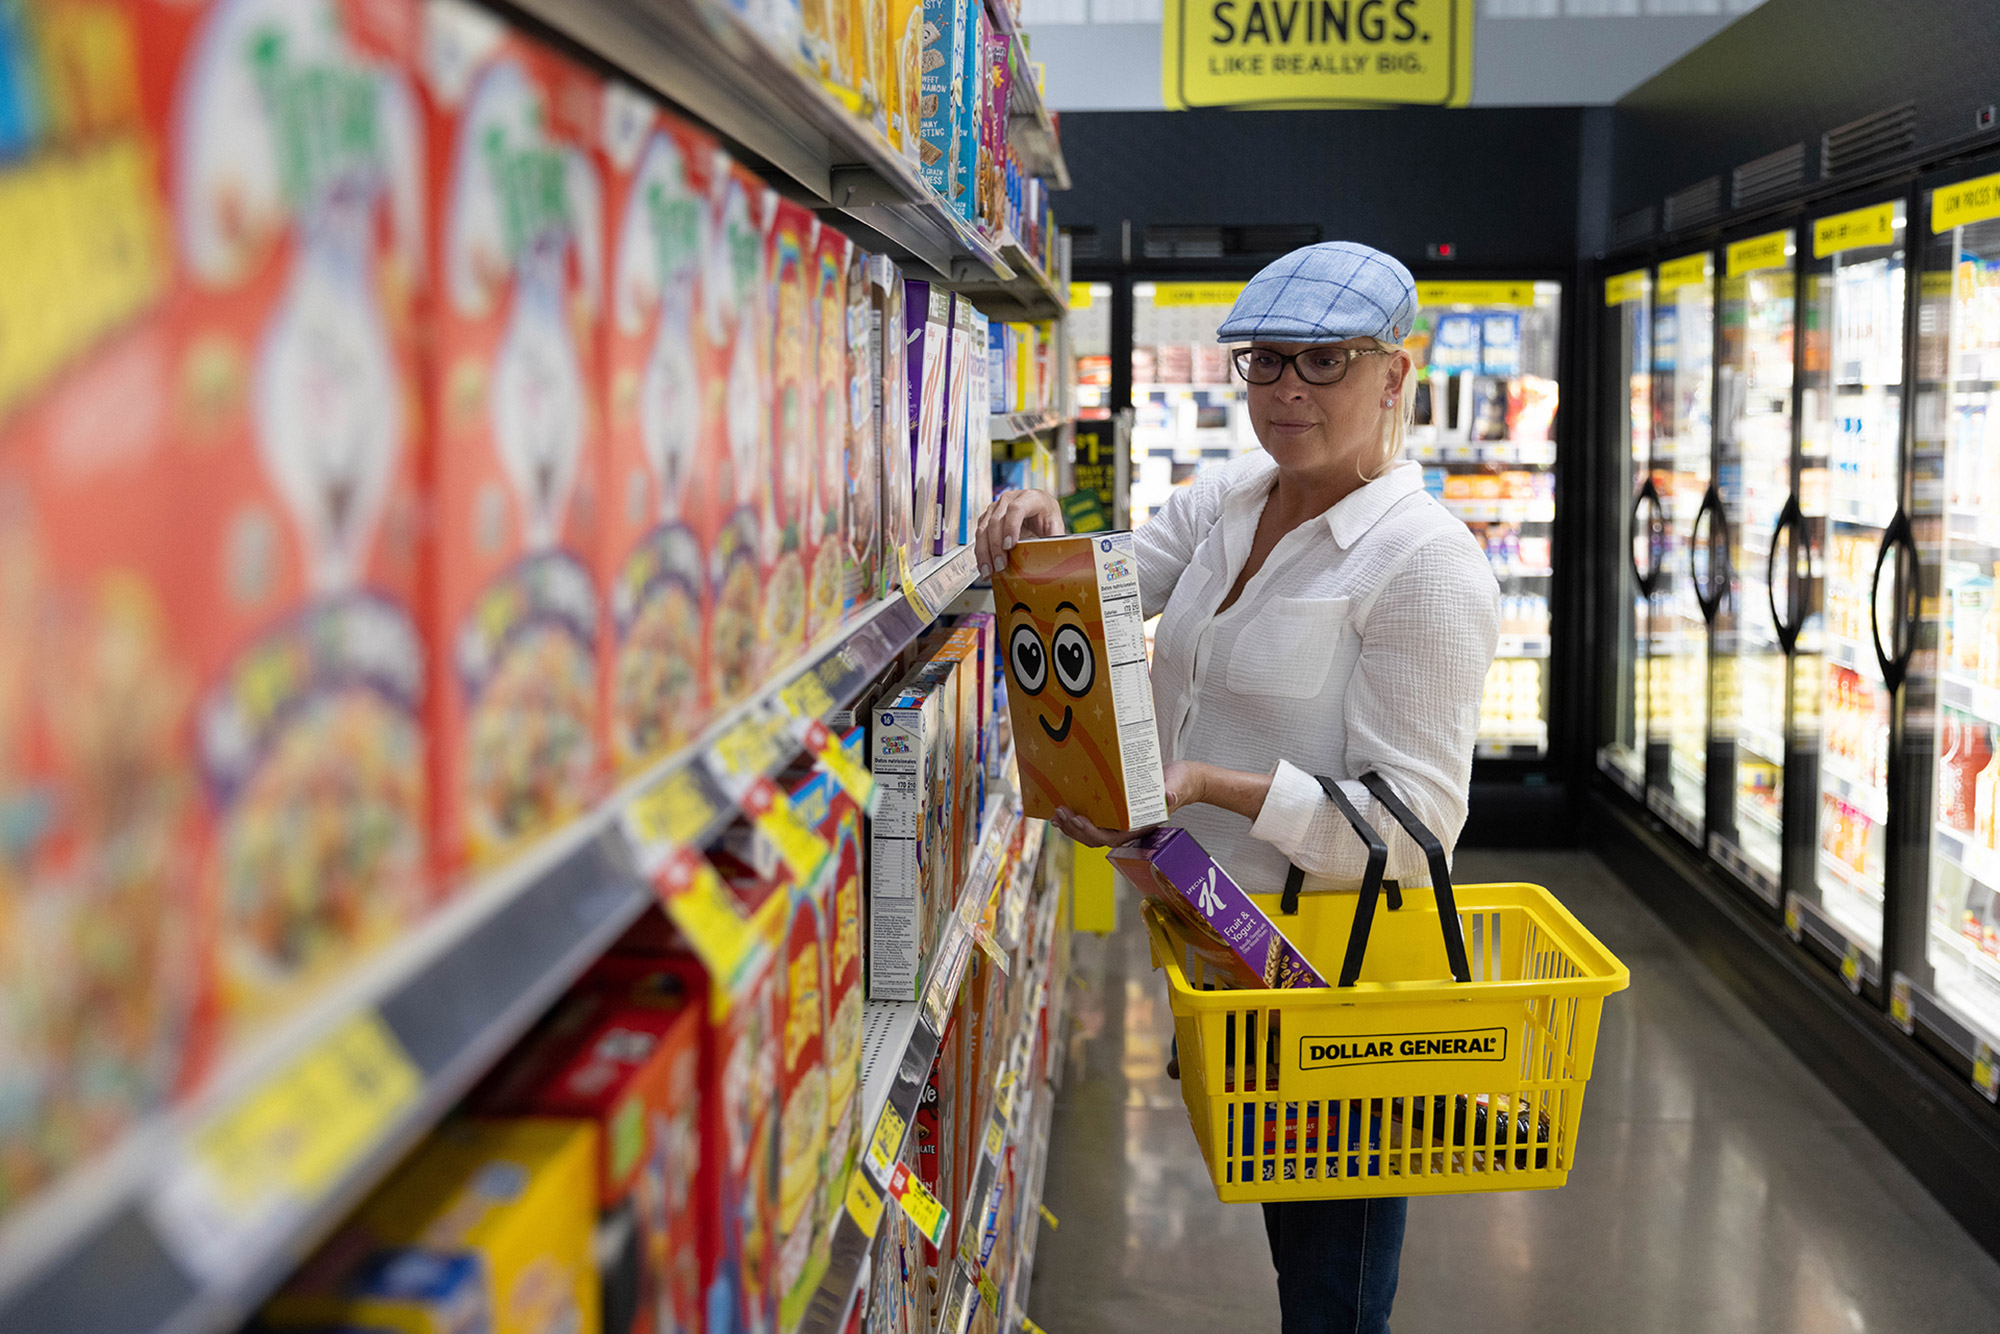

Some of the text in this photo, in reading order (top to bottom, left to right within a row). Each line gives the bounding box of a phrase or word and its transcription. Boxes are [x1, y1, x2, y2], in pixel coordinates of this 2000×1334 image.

[1211, 0, 1431, 45] SAVINGS.
[1208, 53, 1427, 76] LIKE REALLY BIG.
[1186, 876, 1206, 896] SPECIAL
[1198, 866, 1227, 917] K
[1223, 911, 1251, 937] Fruit &
[1230, 918, 1258, 943] Yogurt
[1309, 1041, 1394, 1061] DOLLAR
